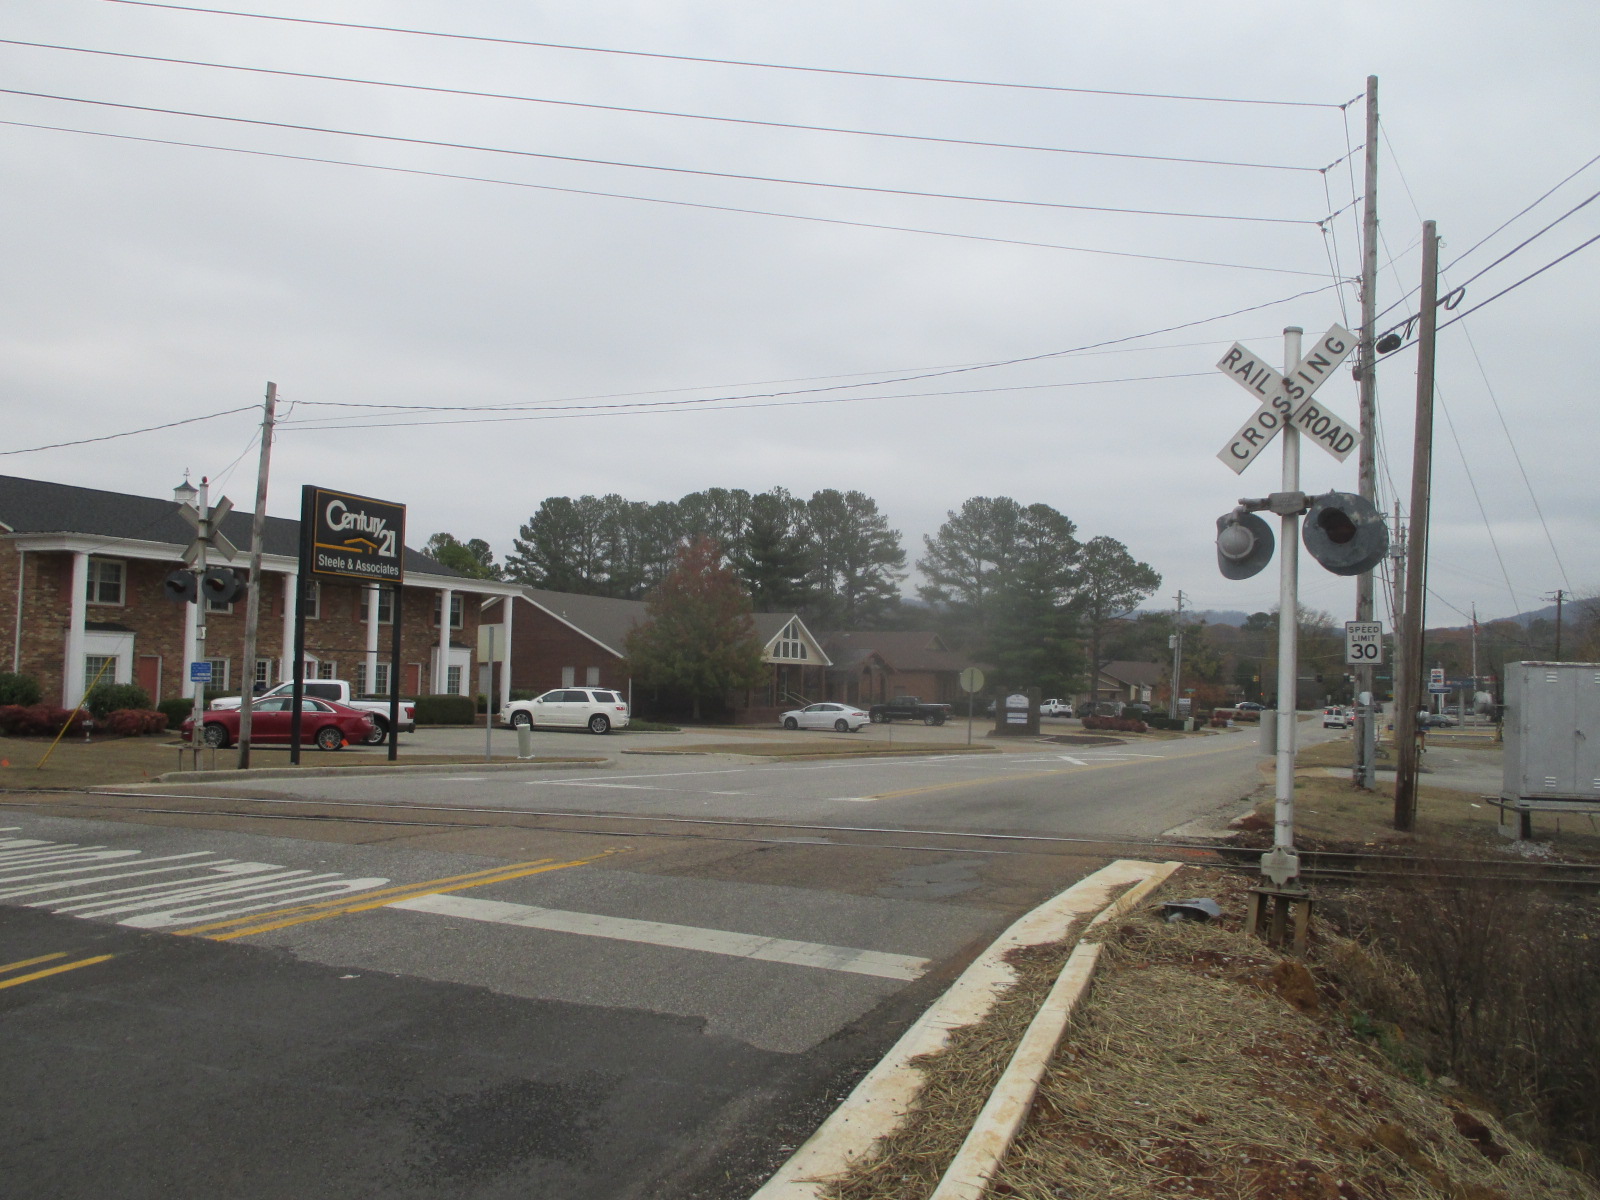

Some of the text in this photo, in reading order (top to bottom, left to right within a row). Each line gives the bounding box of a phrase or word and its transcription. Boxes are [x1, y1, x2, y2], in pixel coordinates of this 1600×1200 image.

[1222, 347, 1354, 453] RAIL ROAD
[1230, 337, 1345, 460] CROSSING
[326, 500, 386, 538] Century
[378, 529, 396, 558] 21
[318, 554, 345, 568] Steele
[347, 559, 354, 570] &
[355, 560, 399, 576] Associates
[1351, 643, 1378, 659] 30
